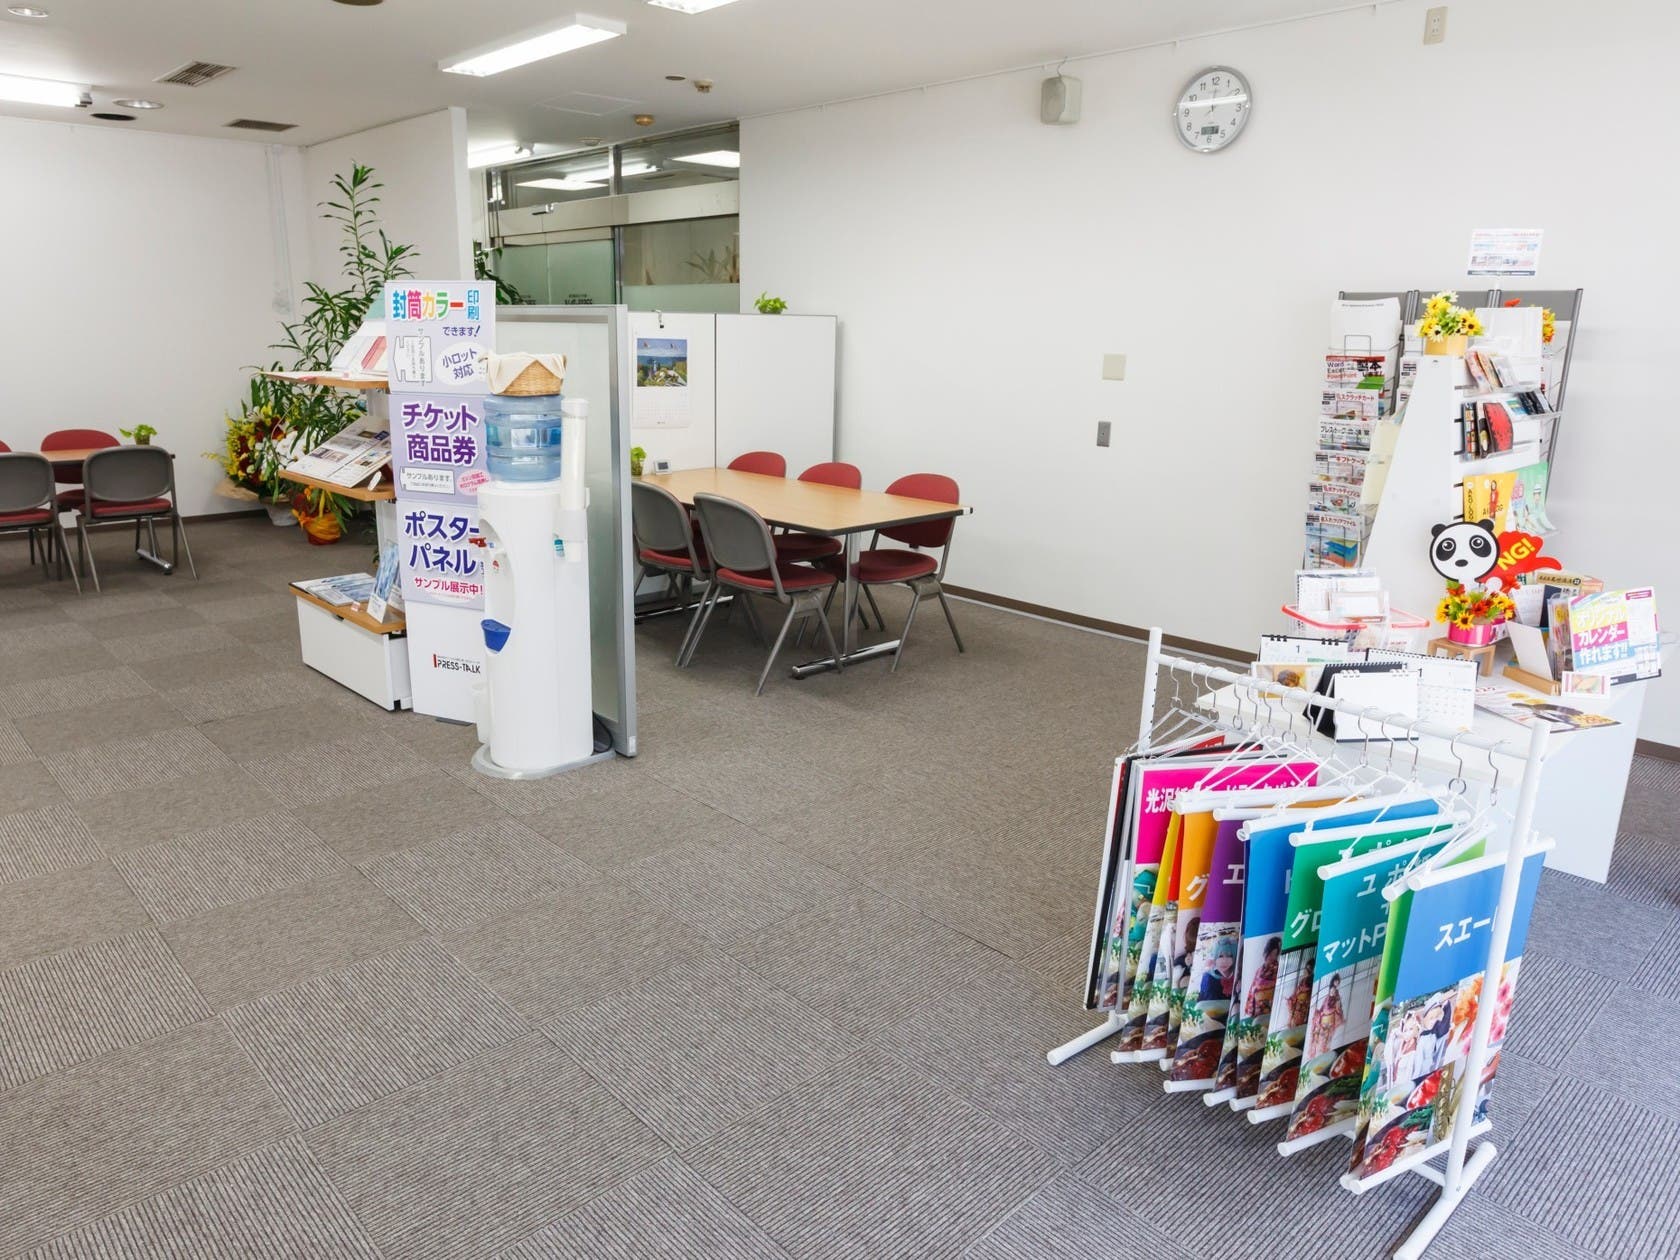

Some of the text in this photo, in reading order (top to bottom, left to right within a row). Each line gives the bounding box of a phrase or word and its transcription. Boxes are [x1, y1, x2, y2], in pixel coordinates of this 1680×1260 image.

[1212, 76, 1220, 85] 12
[1184, 108, 1190, 117] 9
[1235, 103, 1242, 112] 3
[1186, 122, 1192, 131] 8
[1230, 118, 1237, 126] 4
[1207, 135, 1212, 143] 6
[1219, 129, 1226, 138] 5
[442, 348, 477, 368] 小ロット
[453, 364, 474, 380] 対応
[402, 403, 478, 431] チケット
[406, 433, 477, 465] 商品券
[404, 510, 480, 542] ポスター
[409, 542, 477, 574] パネル
[414, 577, 484, 596] サンプル展示中!
[1578, 624, 1625, 647] カレンダー
